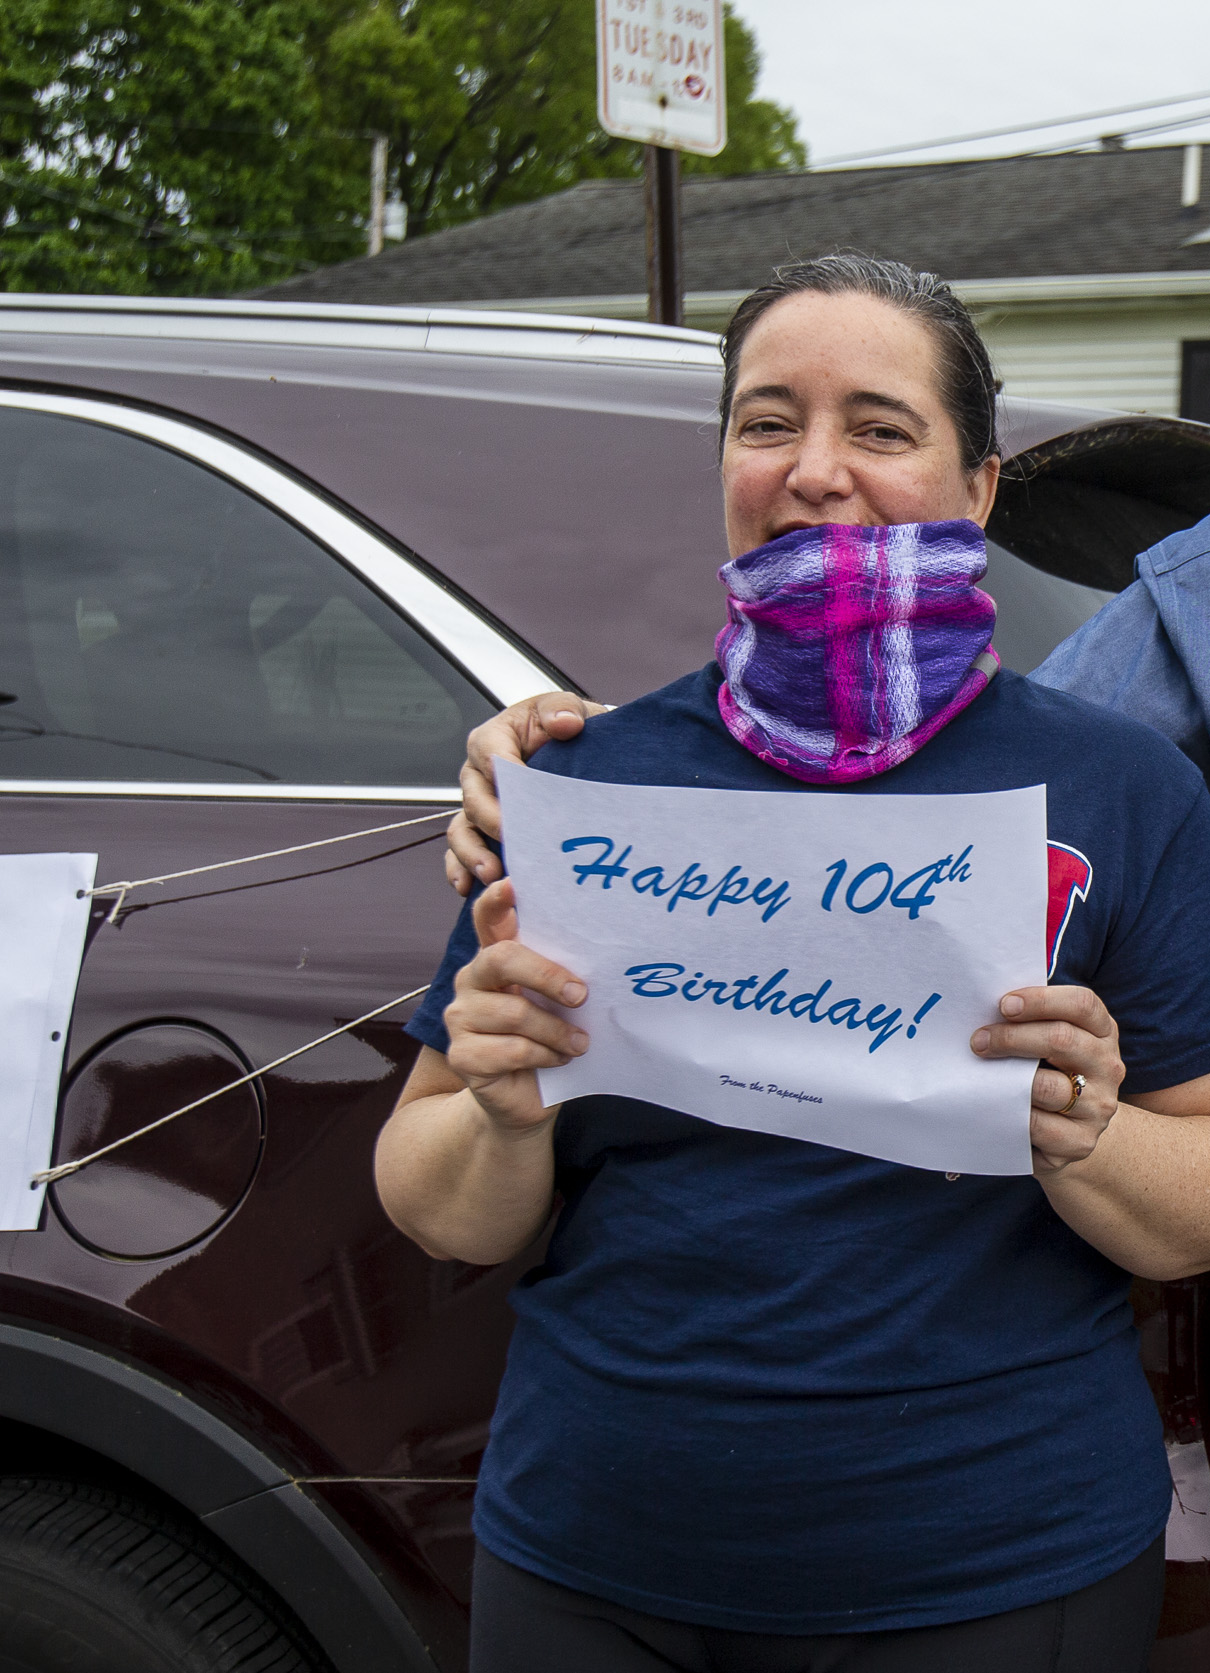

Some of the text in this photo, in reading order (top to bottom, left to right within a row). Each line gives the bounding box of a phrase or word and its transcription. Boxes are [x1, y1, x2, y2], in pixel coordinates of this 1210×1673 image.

[610, 18, 713, 73] TUESDAY
[561, 836, 974, 924] Happy 104th
[623, 962, 943, 1054] Birthday!
[719, 1074, 823, 1104] From the Papenfuses
